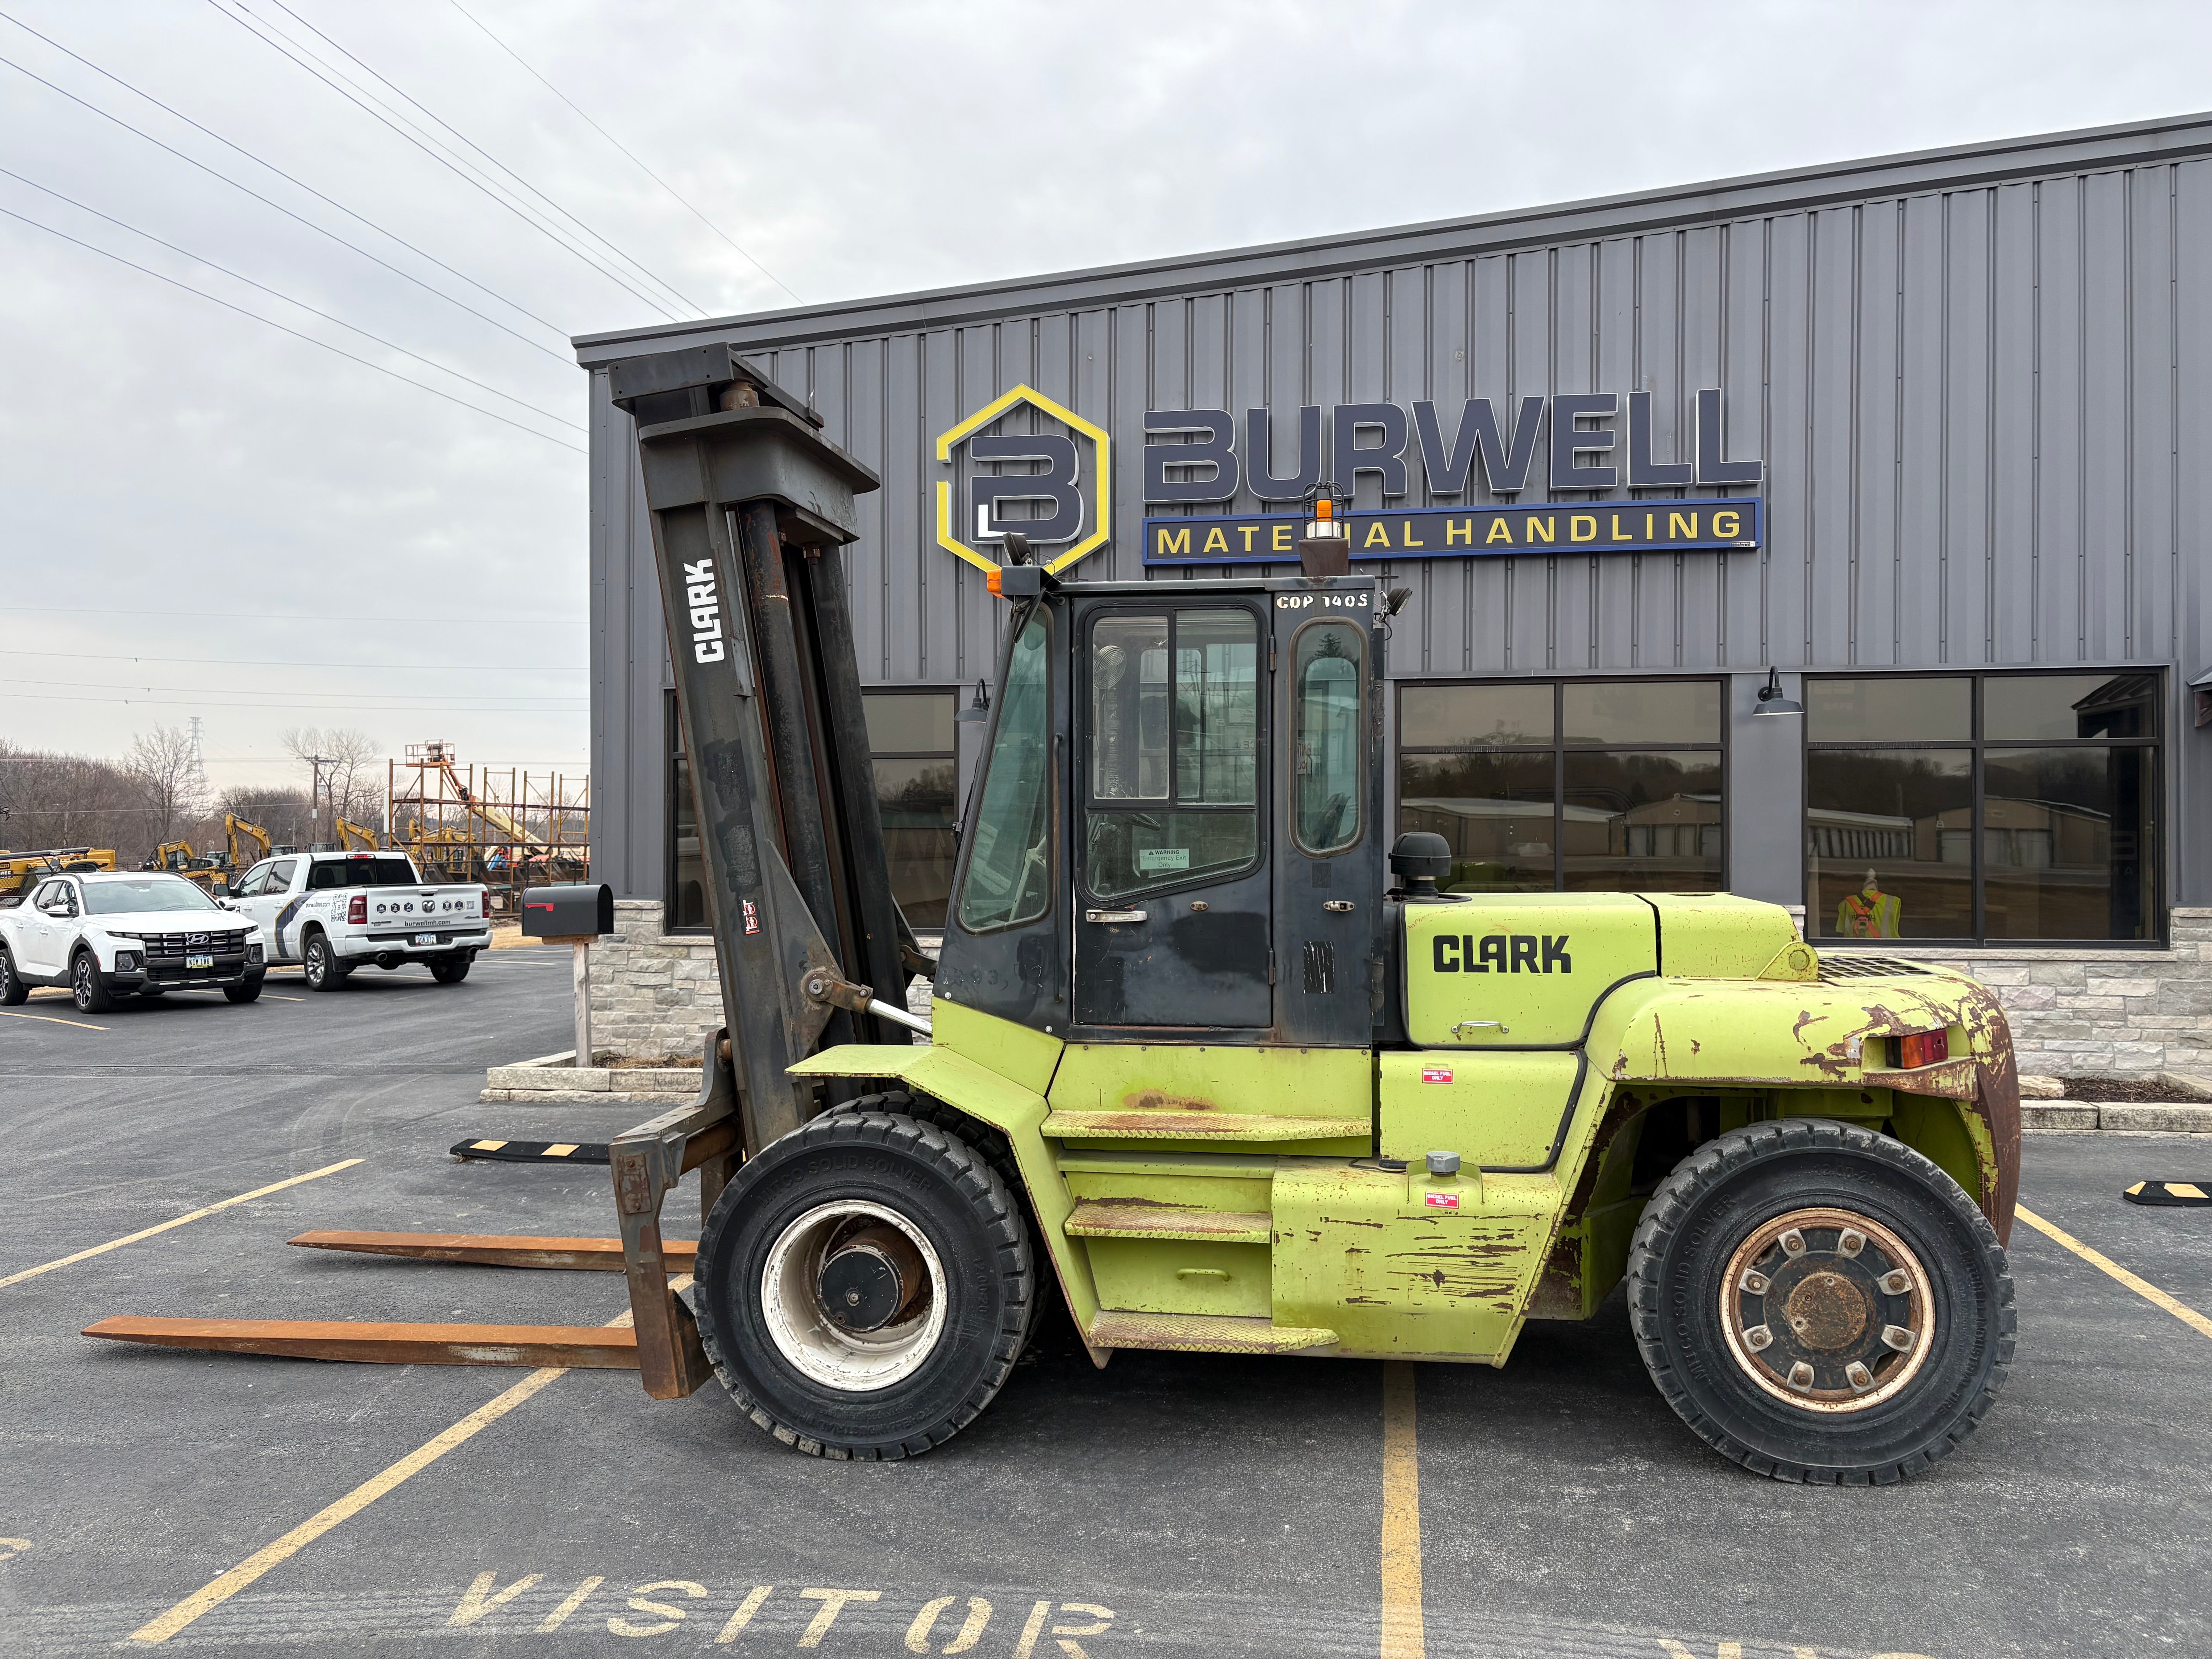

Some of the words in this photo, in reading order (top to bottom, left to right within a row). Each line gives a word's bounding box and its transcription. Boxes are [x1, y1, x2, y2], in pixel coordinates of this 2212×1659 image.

[1143, 388, 1764, 502] BURWELL
[1158, 521, 1424, 554] MATEIAL
[1446, 511, 1740, 545] HANDLING
[682, 558, 725, 664] CLARK
[1322, 594, 1368, 608] 140S
[1433, 935, 1571, 974] CLARK
[755, 1167, 805, 1209] MITCO
[807, 1155, 859, 1175] SOLID
[864, 1156, 934, 1197] SOLVER
[1683, 1194, 1737, 1260] SOLVER
[1673, 1262, 1692, 1317] SOLID
[1676, 1323, 1709, 1382] MITCO
[445, 1571, 1116, 1659] VISITOR
